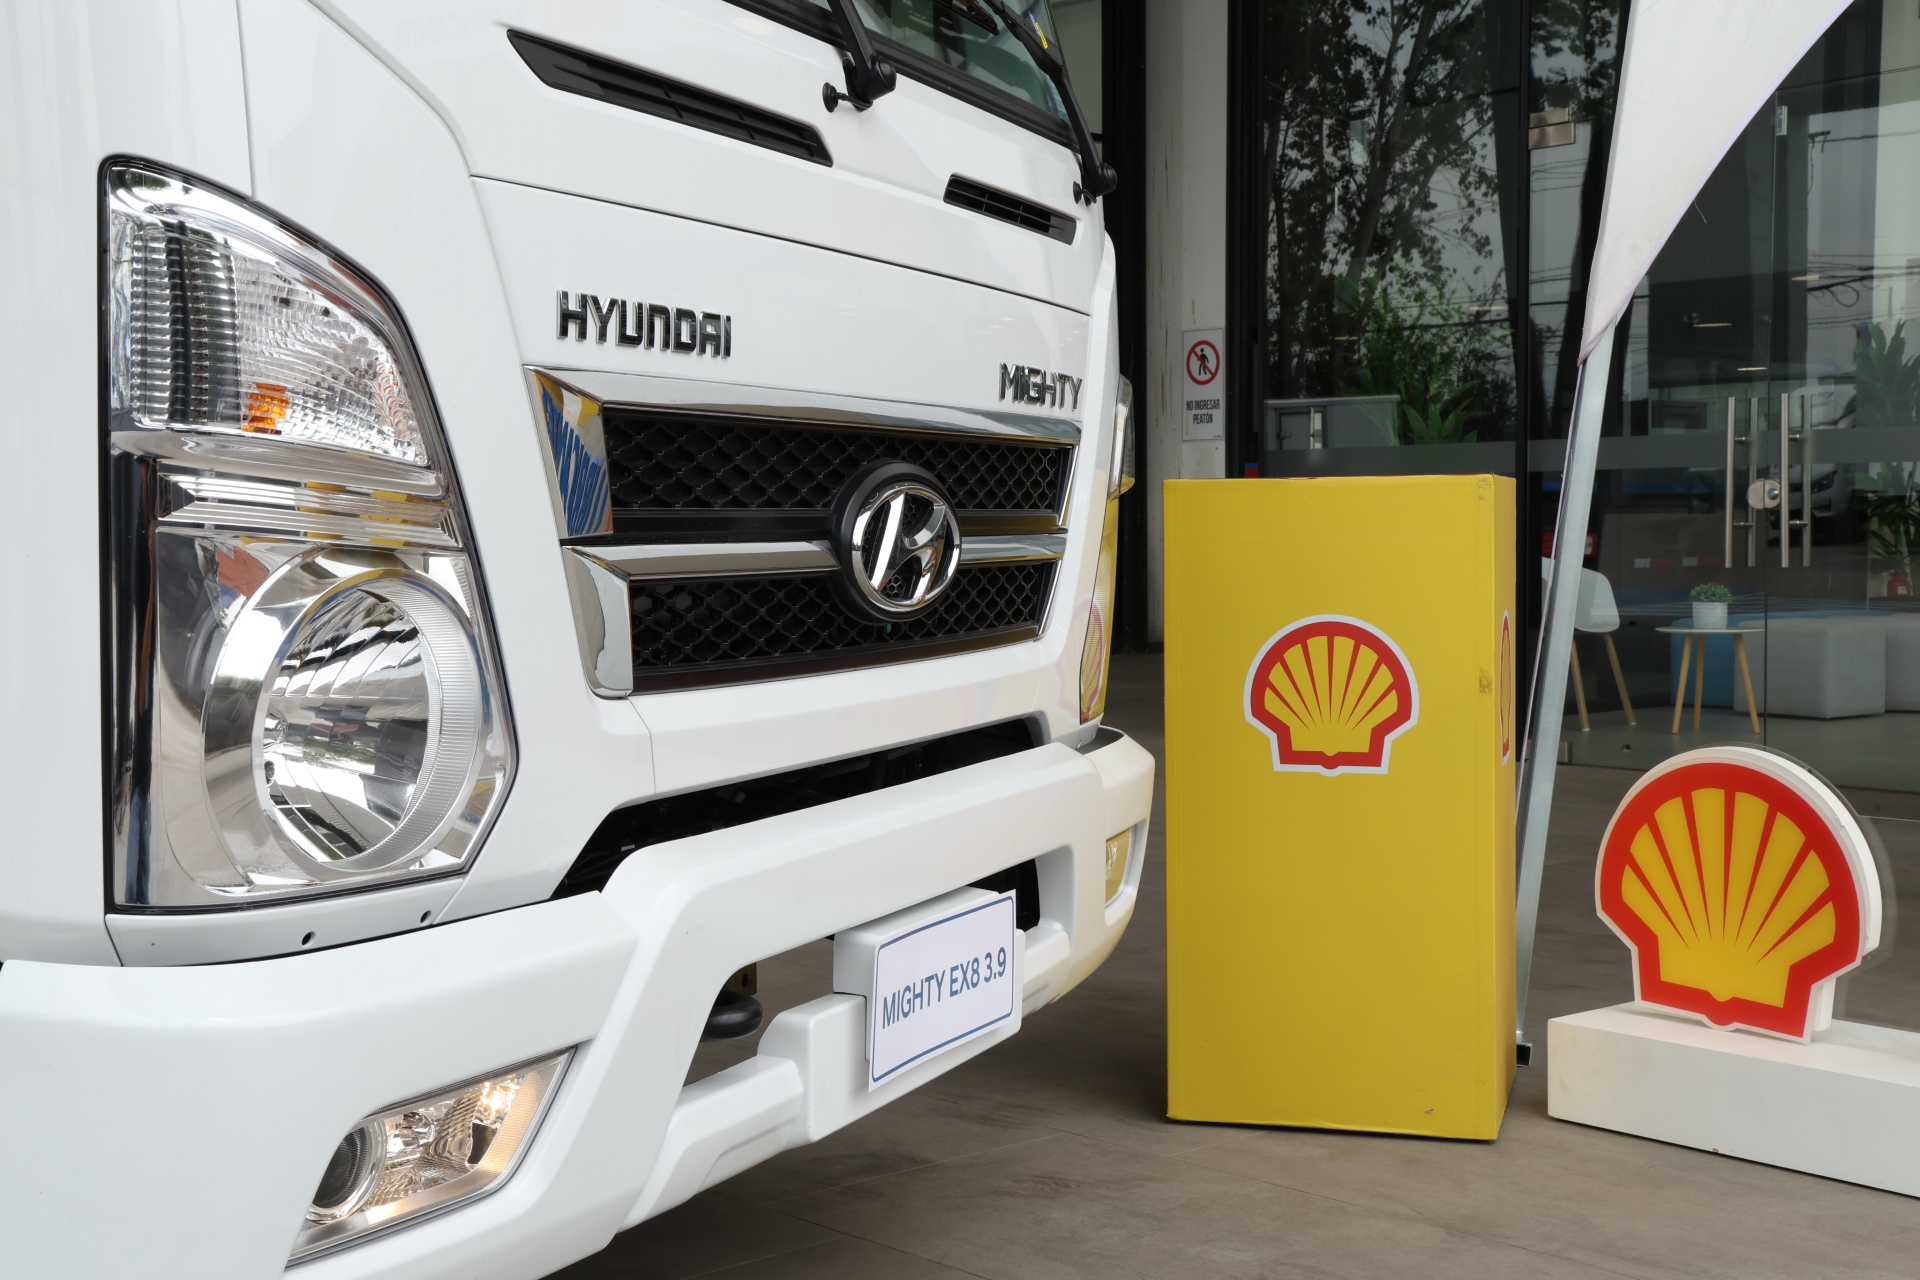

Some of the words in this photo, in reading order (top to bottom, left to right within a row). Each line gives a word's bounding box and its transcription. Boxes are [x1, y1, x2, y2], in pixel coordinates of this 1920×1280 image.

[556, 289, 731, 358] HYUNDAI
[999, 361, 1083, 411] MIGHTY
[1186, 400, 1194, 411] NO
[1195, 399, 1220, 411] INGRESAR
[1193, 412, 1213, 424] PEATÓN
[882, 969, 946, 1029] MIGHTY
[950, 957, 980, 997] EX8
[984, 946, 1007, 983] 3.9
